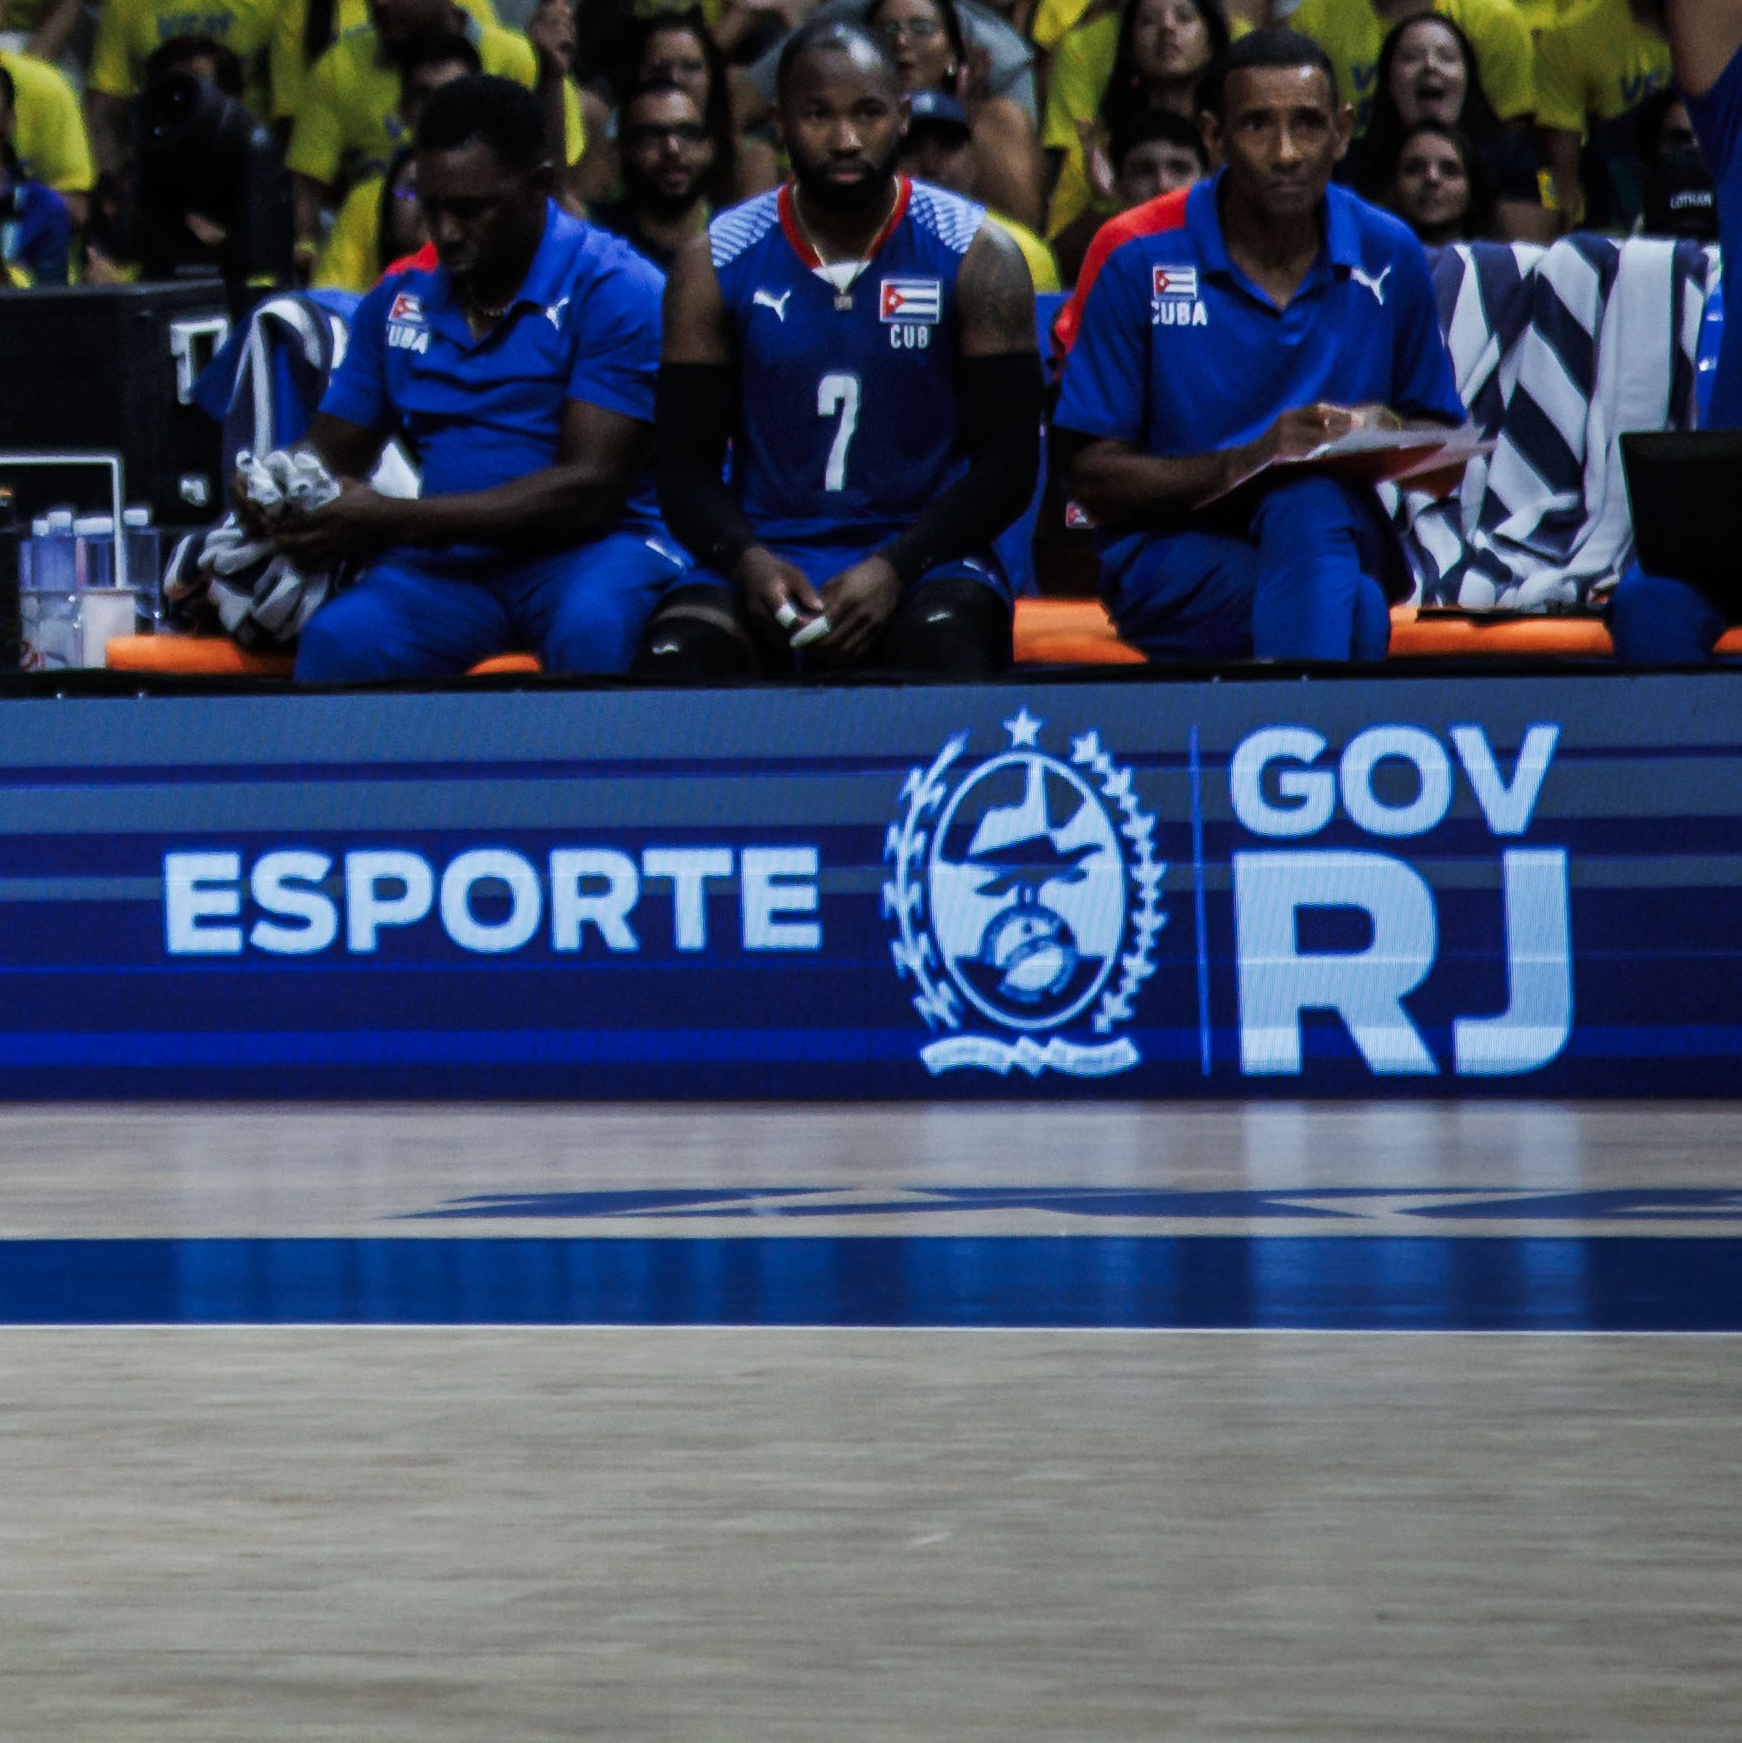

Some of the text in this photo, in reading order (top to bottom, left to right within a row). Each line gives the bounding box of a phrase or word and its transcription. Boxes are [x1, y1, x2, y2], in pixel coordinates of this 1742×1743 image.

[387, 324, 430, 355] UBA
[889, 322, 932, 350] CUB
[817, 373, 861, 492] 7
[1230, 723, 1561, 838] GOV
[164, 846, 822, 955] ESPORTE
[1231, 840, 1573, 1077] RJ
